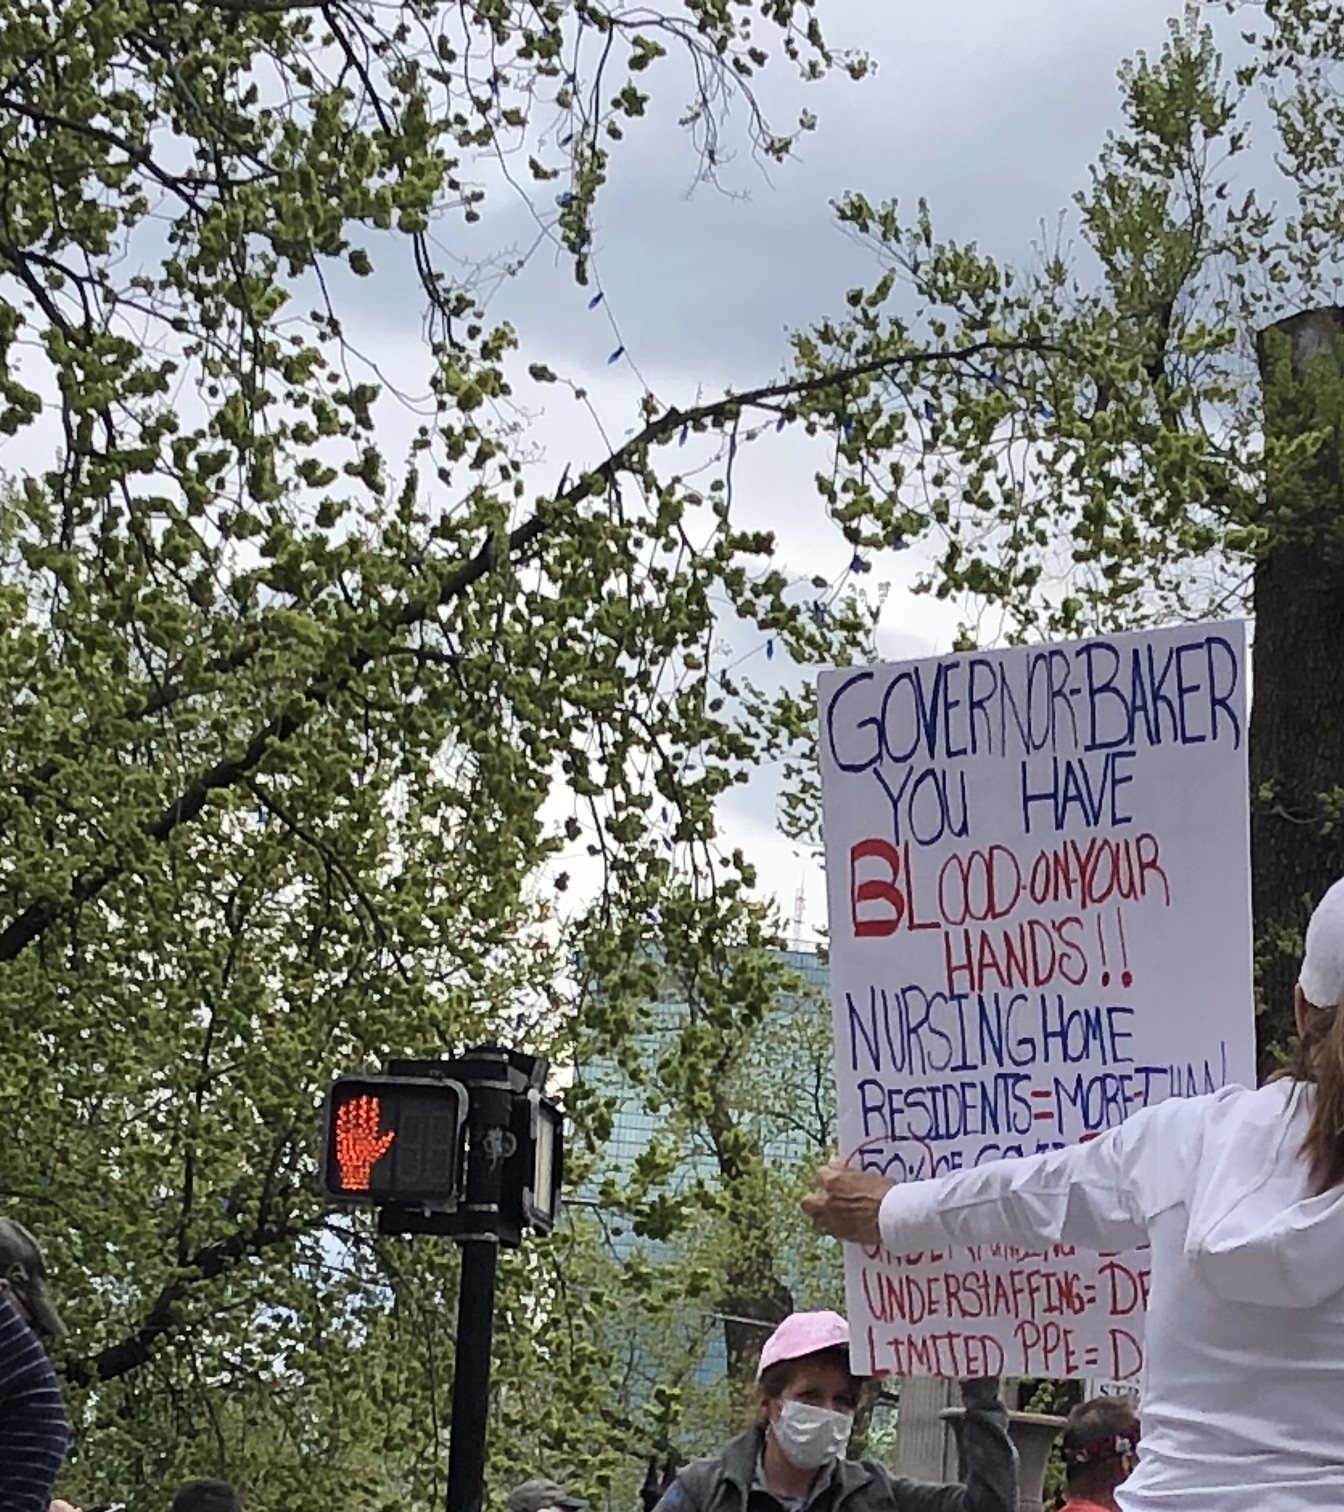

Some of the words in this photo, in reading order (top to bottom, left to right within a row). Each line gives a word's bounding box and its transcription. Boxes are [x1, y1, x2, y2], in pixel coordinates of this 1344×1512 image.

[873, 765, 969, 846] YOU
[1022, 751, 1136, 834] HAVE
[846, 985, 1036, 1075] NURSING
[1040, 993, 1134, 1066] HOME
[867, 1325, 1005, 1379] LIMITED
